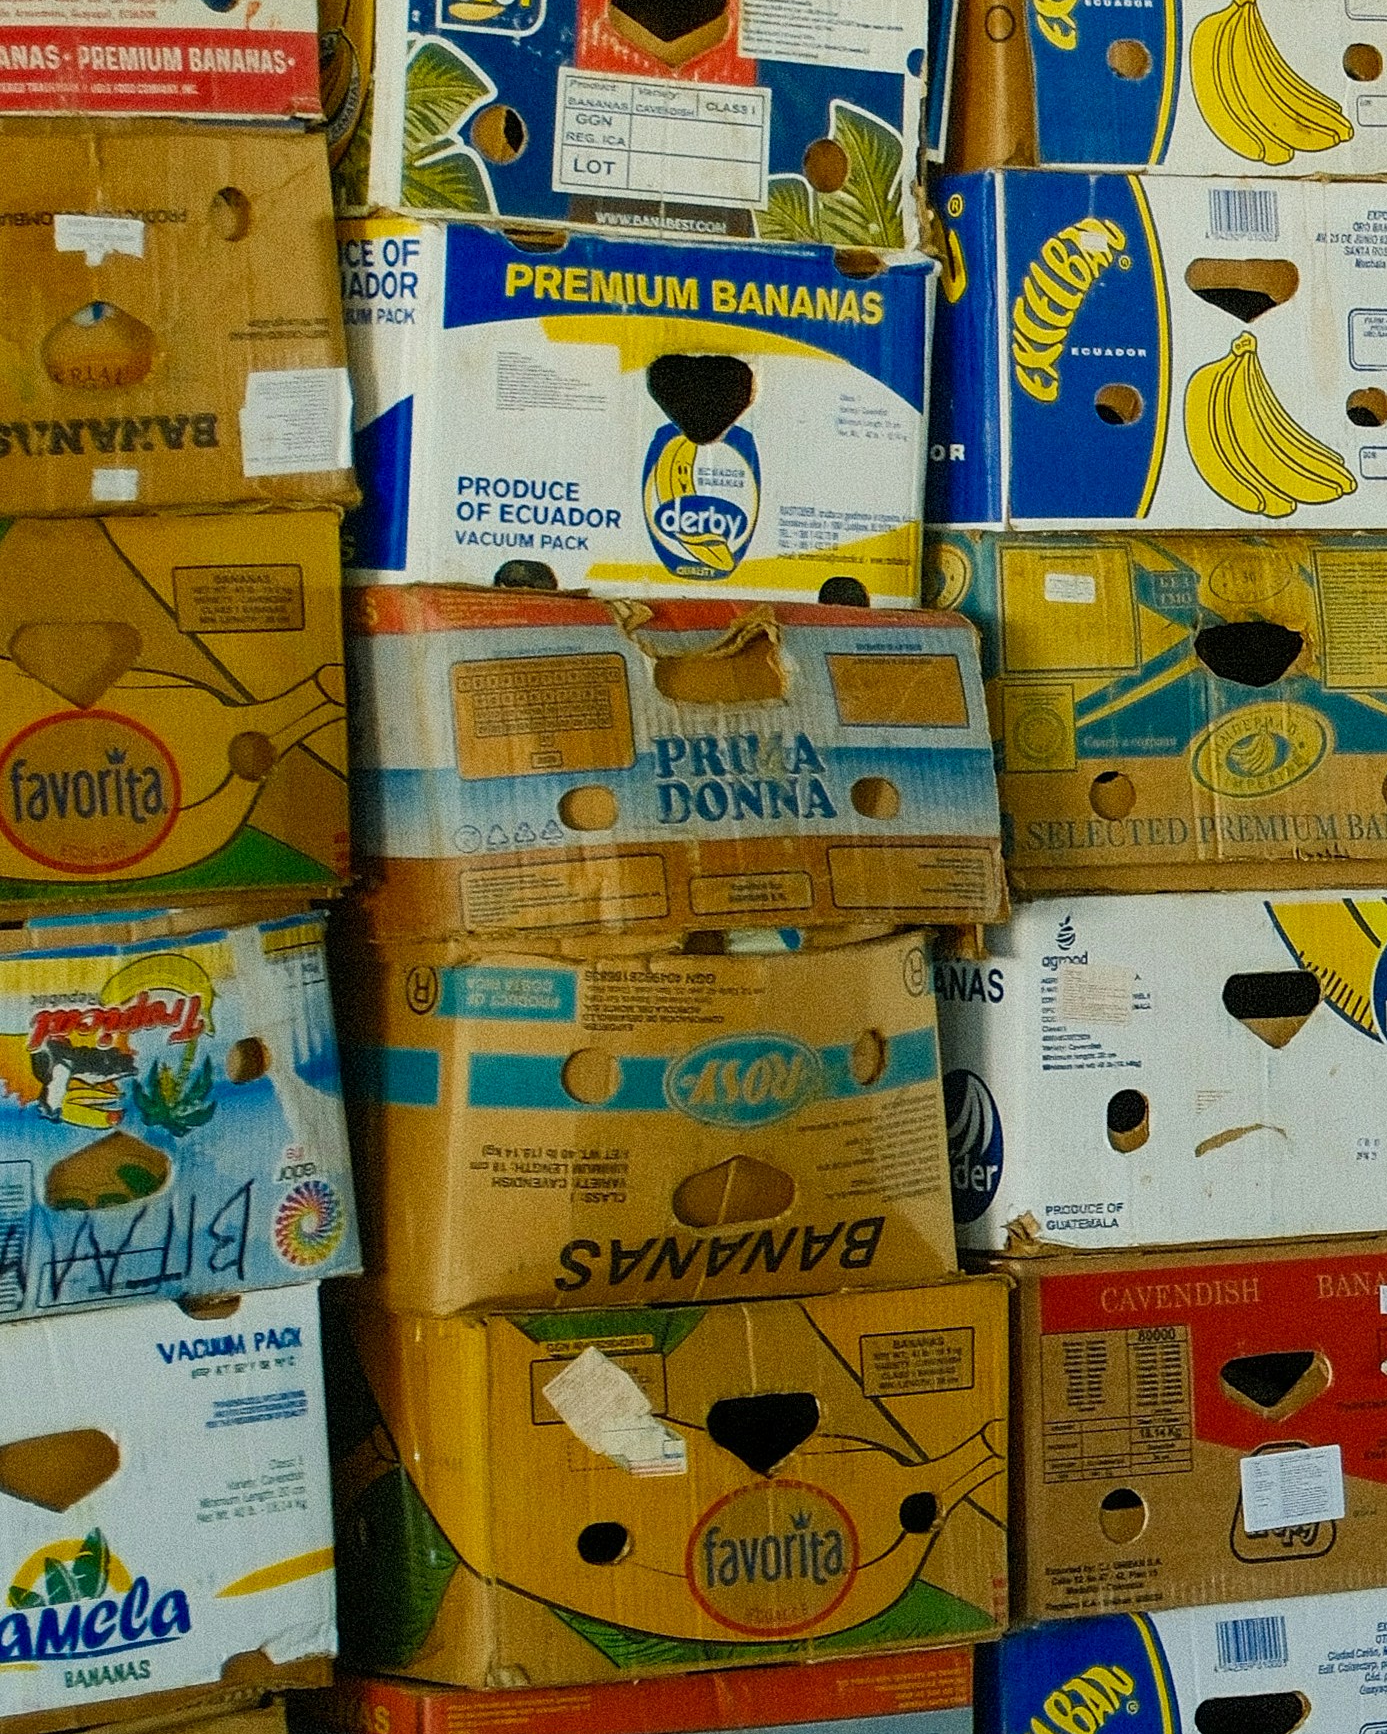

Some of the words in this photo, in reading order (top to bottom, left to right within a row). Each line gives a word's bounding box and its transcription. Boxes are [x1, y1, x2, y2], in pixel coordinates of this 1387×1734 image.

[576, 114, 613, 130] GGN
[573, 158, 616, 176] LOT
[505, 263, 701, 310] PREMIUM
[712, 279, 883, 326] BANANAS
[377, 308, 415, 325] PACK
[1071, 346, 1146, 358] ECUADOR
[458, 477, 580, 502] PRODUCE
[457, 502, 489, 524] OF
[499, 504, 622, 529] ECUADOR
[661, 498, 747, 539] derby
[456, 531, 533, 550] VACUUM
[541, 534, 589, 551] PACK
[654, 734, 825, 776] PRIMA
[9, 757, 169, 824] favorita
[655, 778, 837, 823] DONNA
[1027, 815, 1189, 852] SELECTED
[1199, 813, 1338, 845] PREMIUM
[30, 991, 206, 1046] Tropical
[1045, 1202, 1099, 1216] PRODUCE
[1104, 1202, 1124, 1215] OF
[1046, 1215, 1119, 1231] GUATEMALA
[555, 1217, 885, 1291] BANANAS
[1101, 1278, 1261, 1314] CAVENDISH
[157, 1332, 246, 1365] VACUUM
[253, 1327, 303, 1352] PACK
[704, 1524, 846, 1588] favorita
[64, 1660, 151, 1688] BANANAS
